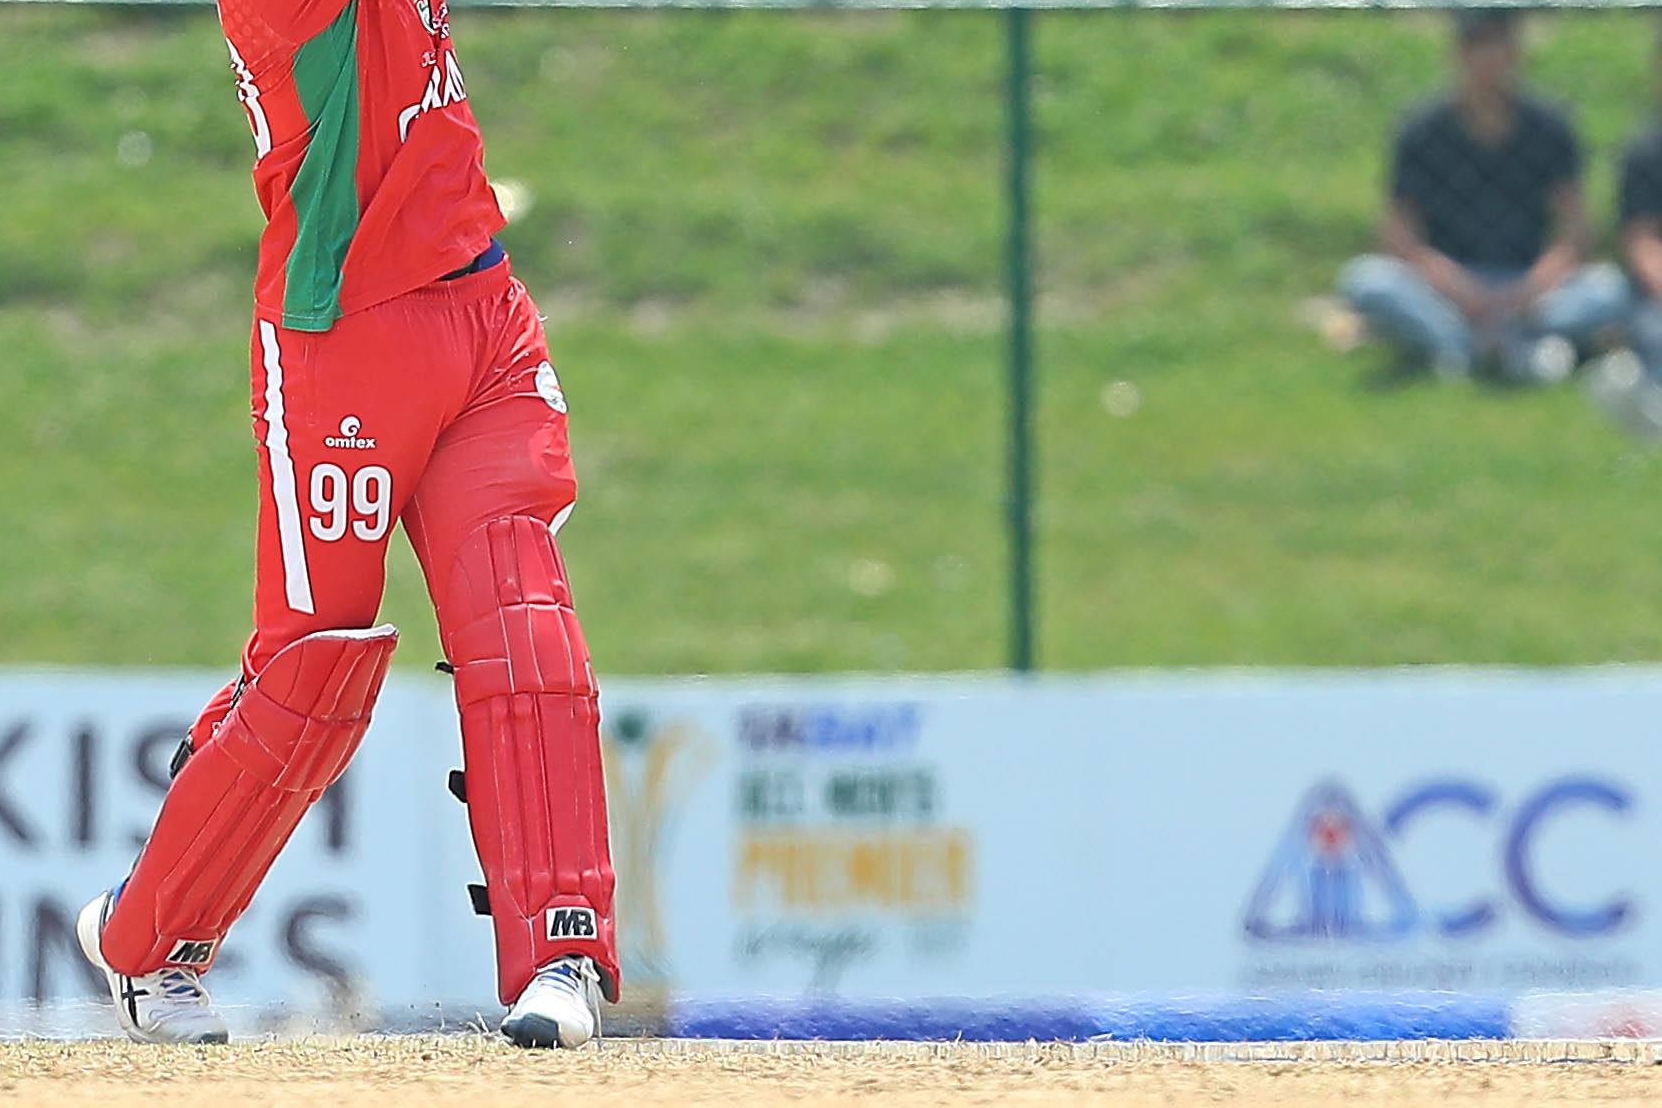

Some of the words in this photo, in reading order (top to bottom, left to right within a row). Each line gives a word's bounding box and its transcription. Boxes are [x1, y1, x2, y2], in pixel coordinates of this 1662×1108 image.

[309, 462, 392, 543] 99
[1243, 774, 1635, 940] ACC
[550, 909, 594, 937] MB
